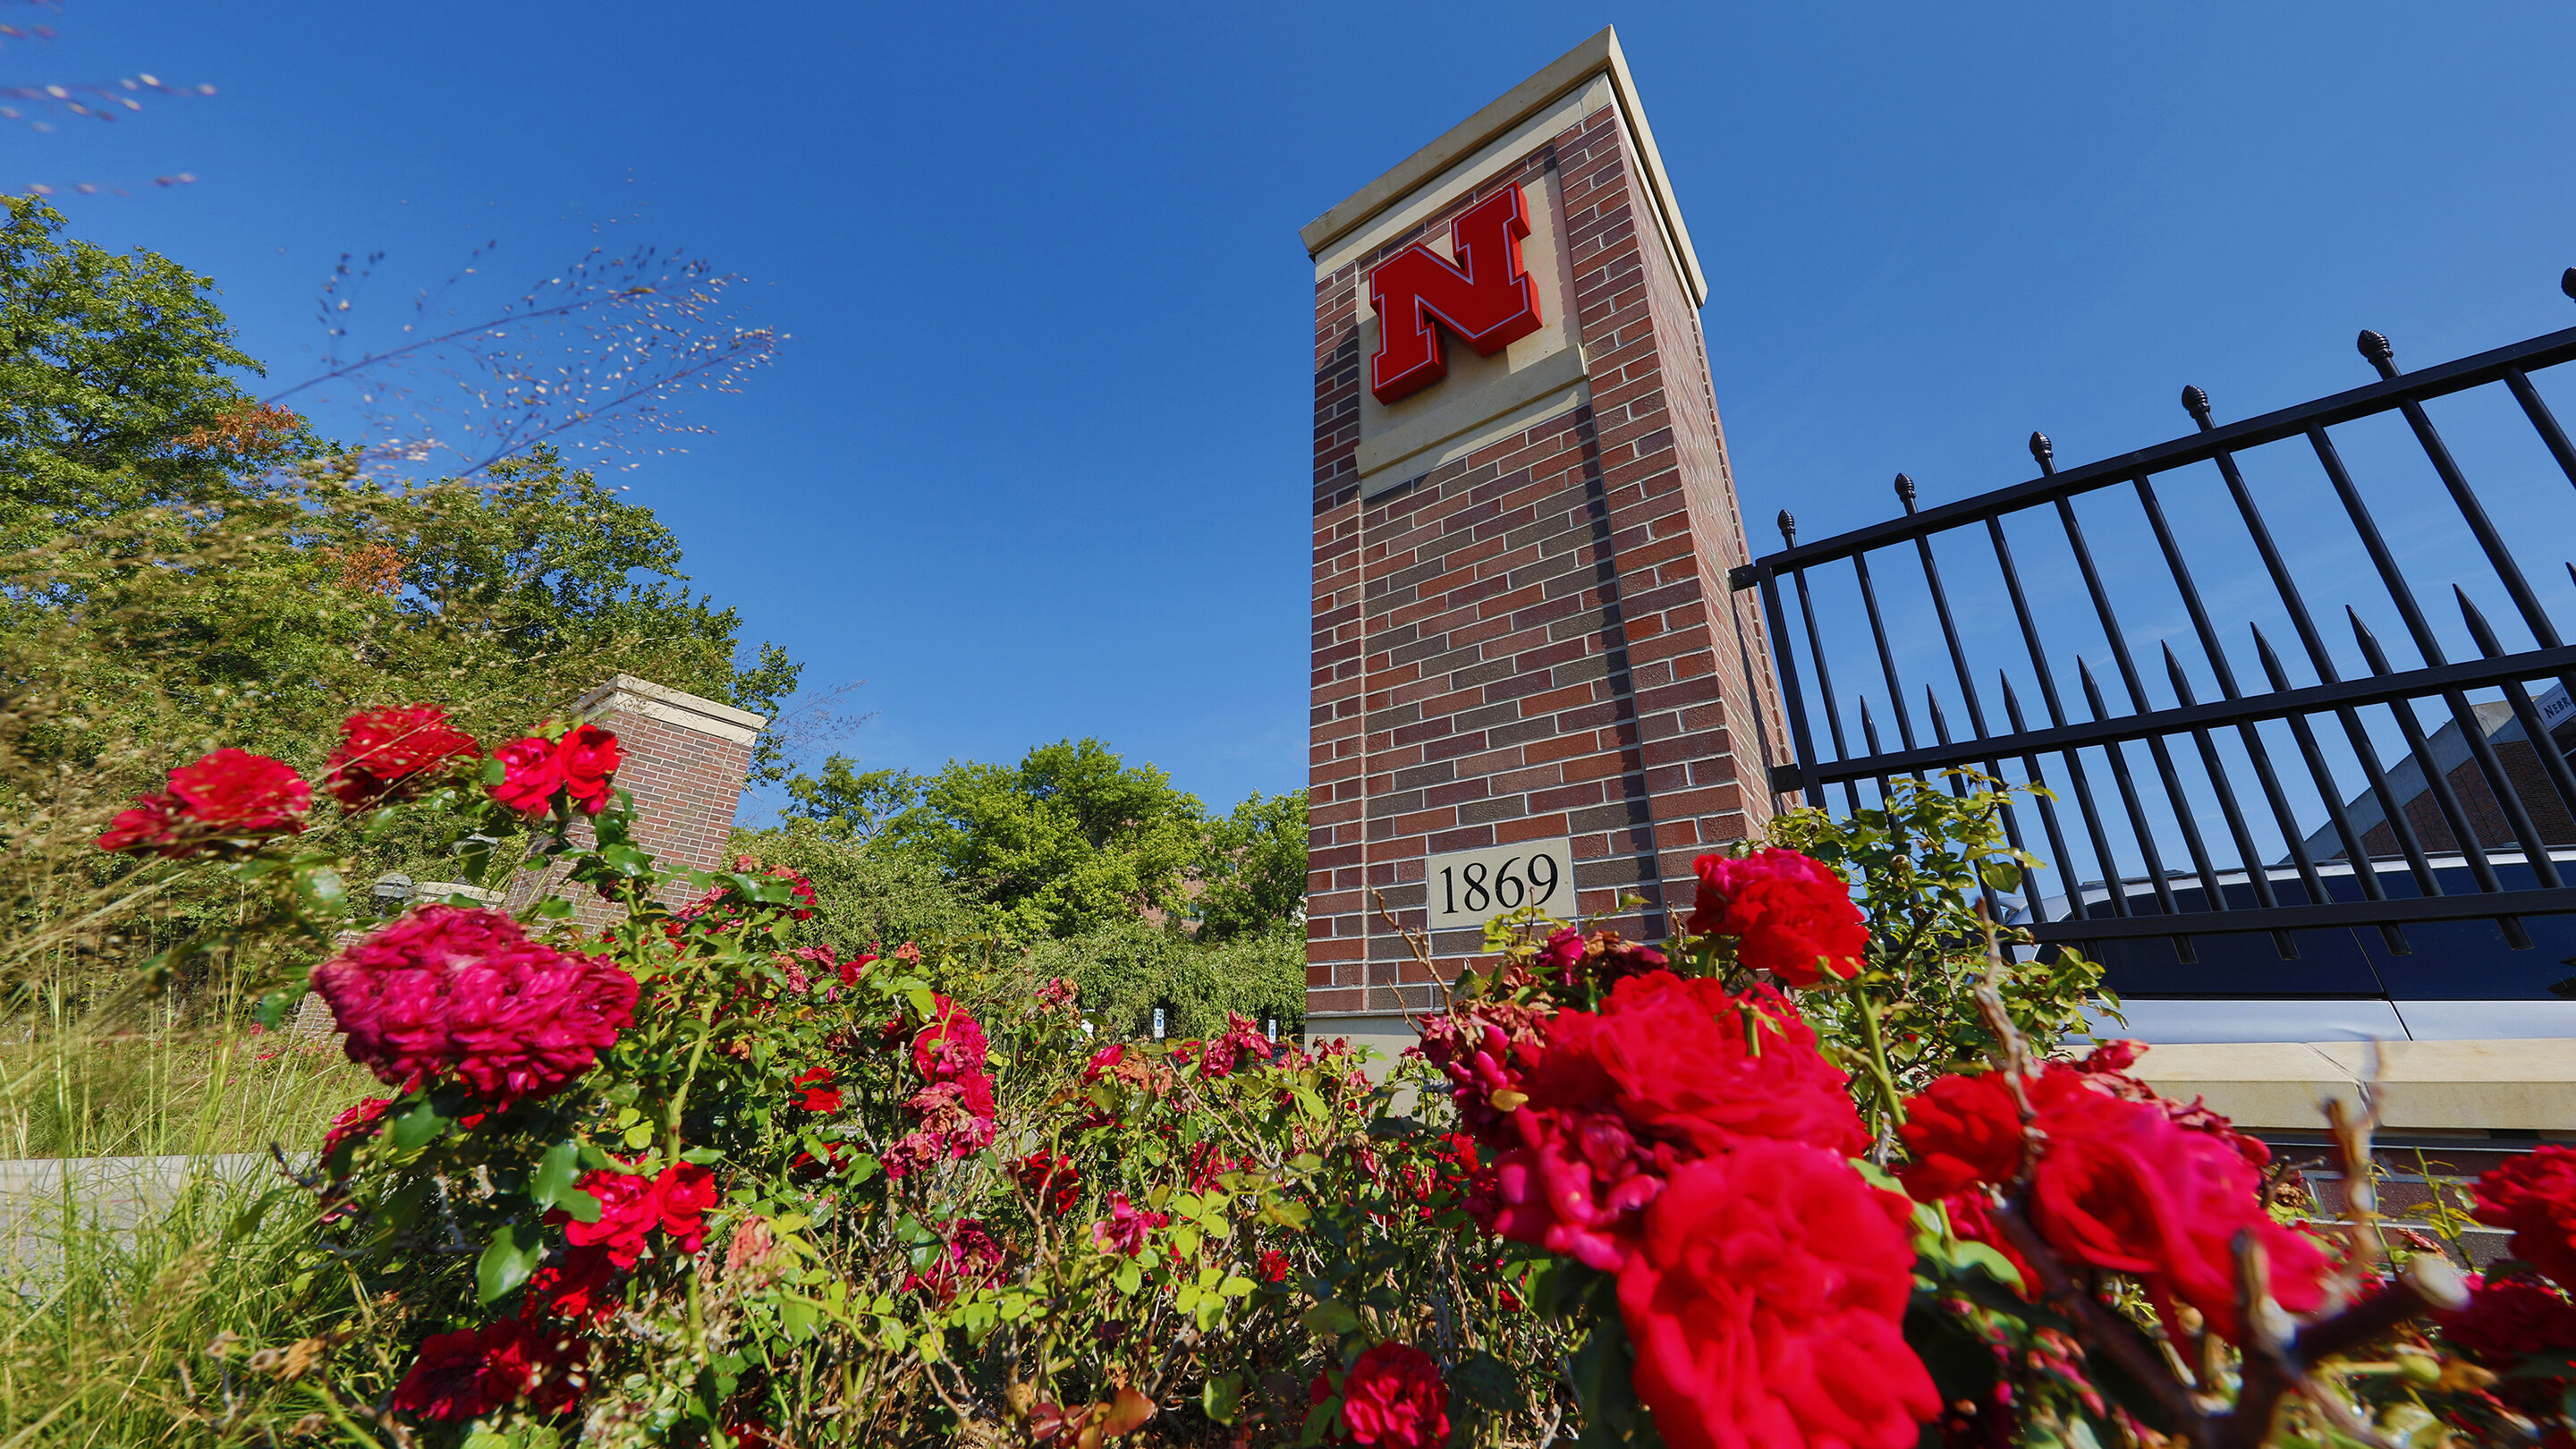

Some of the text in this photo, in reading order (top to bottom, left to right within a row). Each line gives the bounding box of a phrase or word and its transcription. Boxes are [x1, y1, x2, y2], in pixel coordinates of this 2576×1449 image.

[1369, 182, 1543, 405] N
[2543, 697, 2572, 718] NEBR
[1440, 853, 1558, 914] 1869
